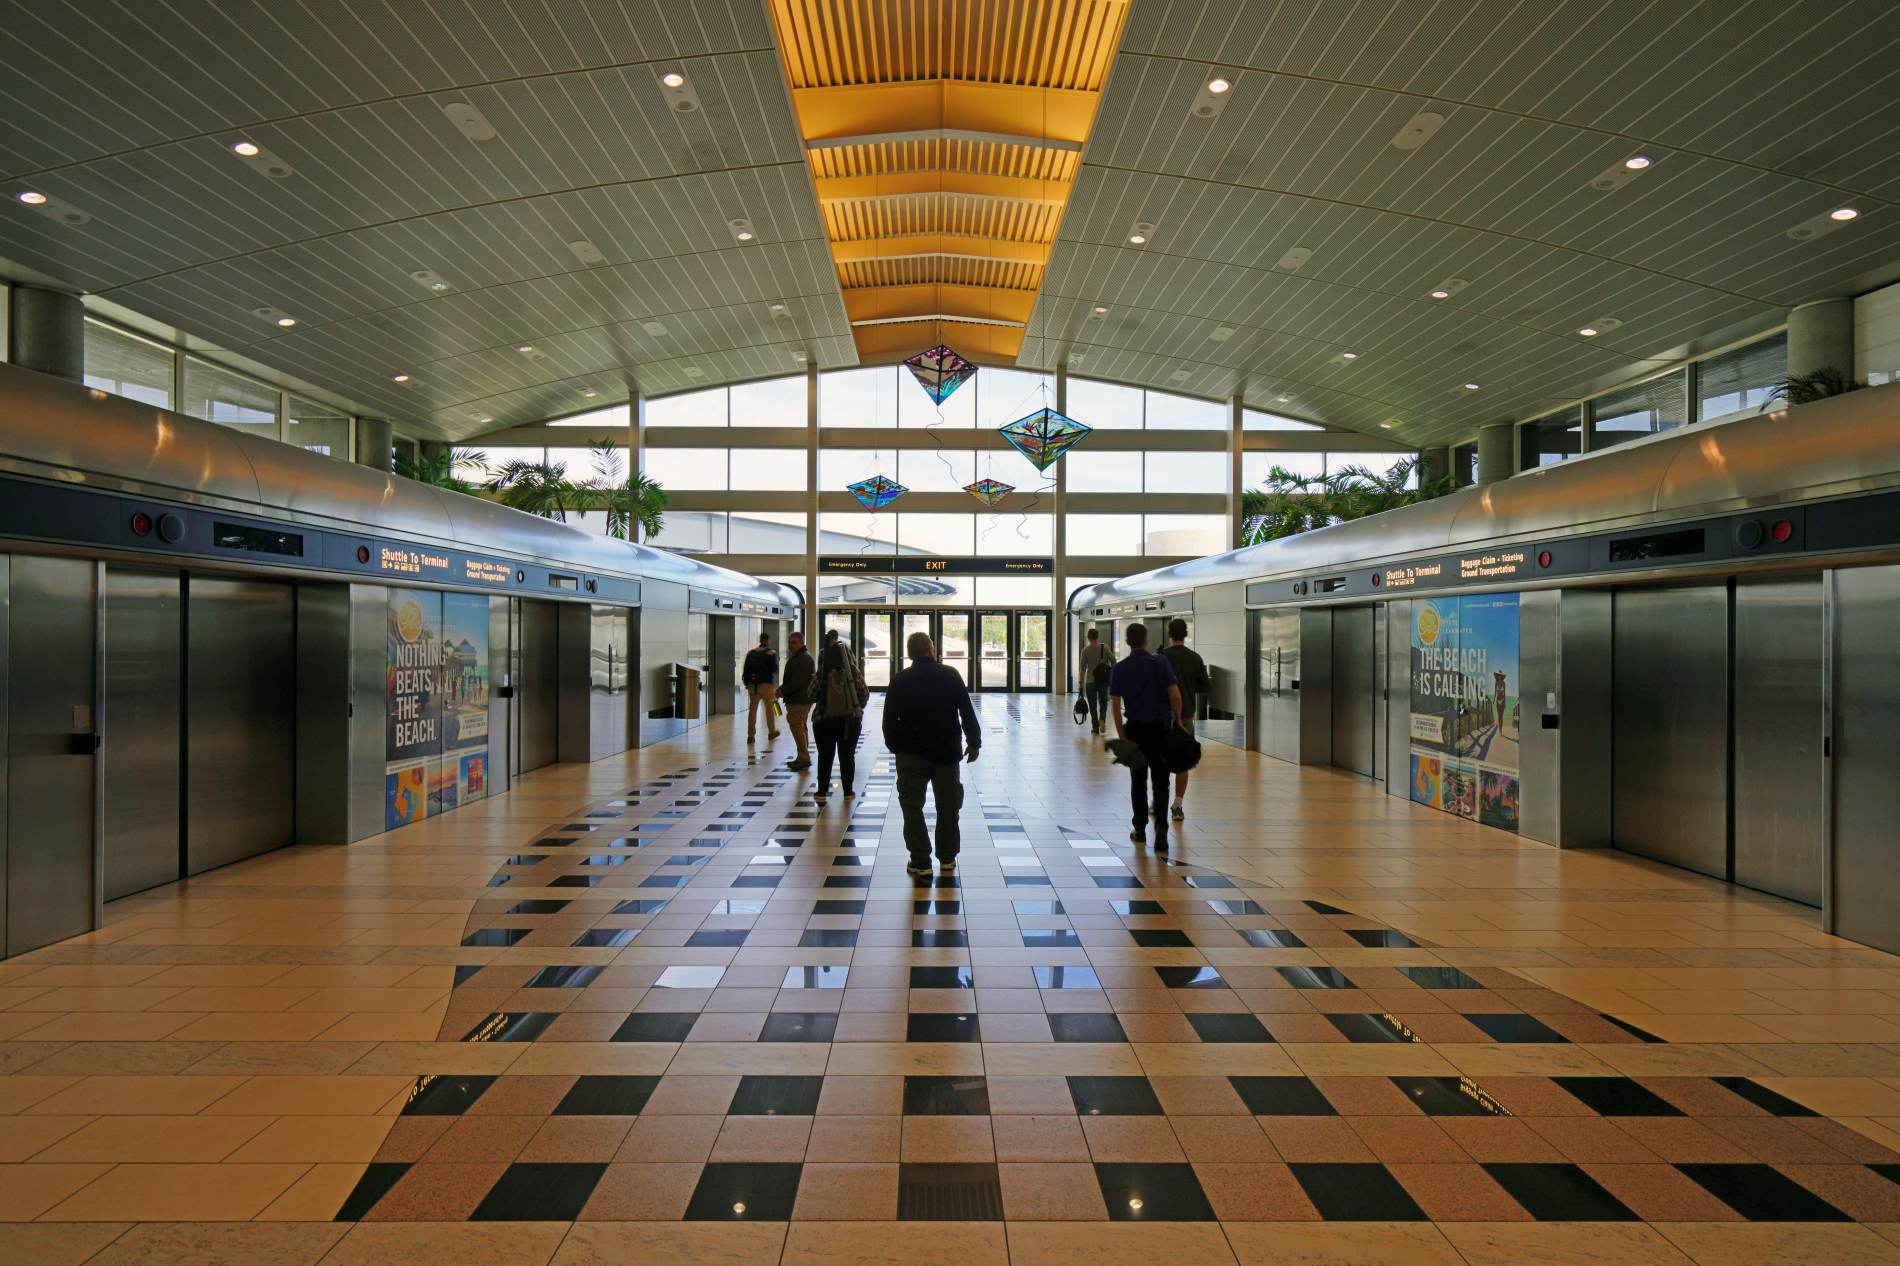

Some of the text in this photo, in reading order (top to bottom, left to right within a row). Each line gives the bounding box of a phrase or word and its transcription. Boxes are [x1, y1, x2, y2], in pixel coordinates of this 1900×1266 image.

[382, 548, 448, 568] Shuttle To Terminal
[926, 561, 947, 570] EXIT
[1461, 552, 1523, 569] Baggage Claim Ticketing
[1386, 564, 1441, 579] Shuttle To Terminal
[1461, 564, 1516, 578] Ground Transportation
[396, 640, 446, 667] NOTHING
[1420, 647, 1486, 673] THE BEACH
[396, 669, 432, 695] BEATS
[1420, 672, 1430, 696] IS
[396, 695, 419, 721] THE
[396, 718, 437, 748] BEACH.
